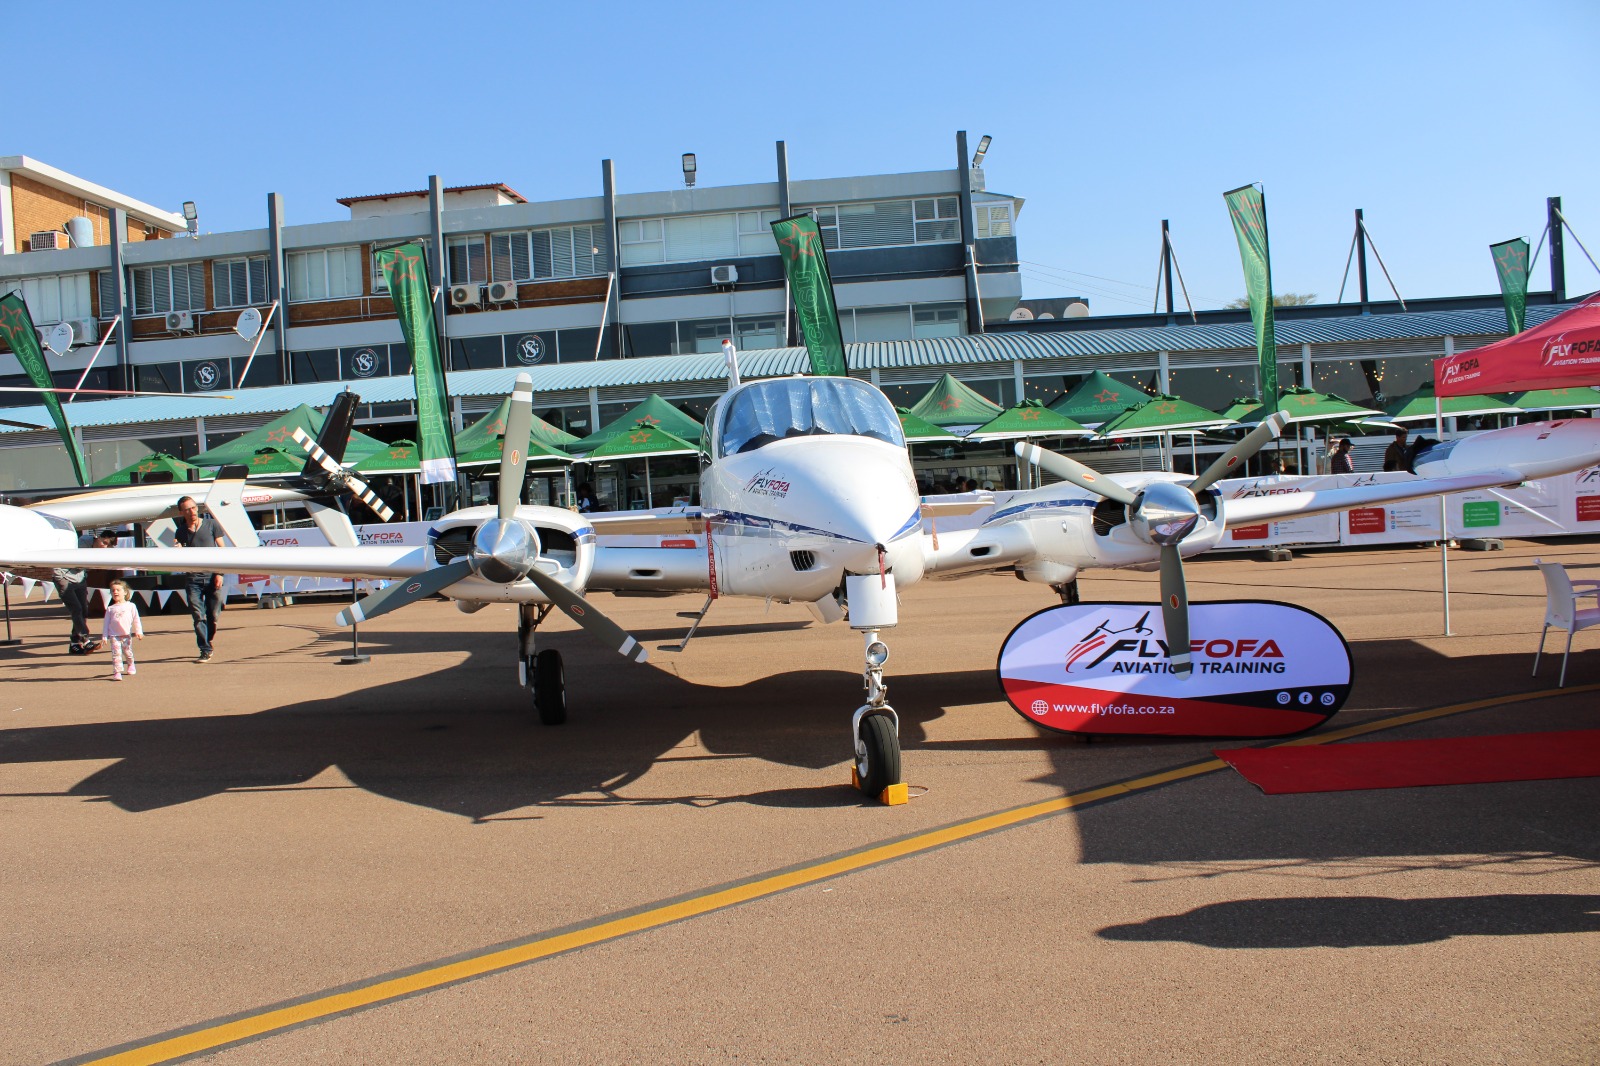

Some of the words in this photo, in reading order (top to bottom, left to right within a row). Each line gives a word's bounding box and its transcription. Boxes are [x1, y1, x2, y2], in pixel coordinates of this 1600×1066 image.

[1443, 358, 1479, 385] FLYFOFA
[260, 538, 299, 547] YFOFA
[1112, 661, 1195, 675] AVIATI
[1201, 662, 1287, 674] TRAINING
[1053, 702, 1176, 716] www.flyfofa.co.za
